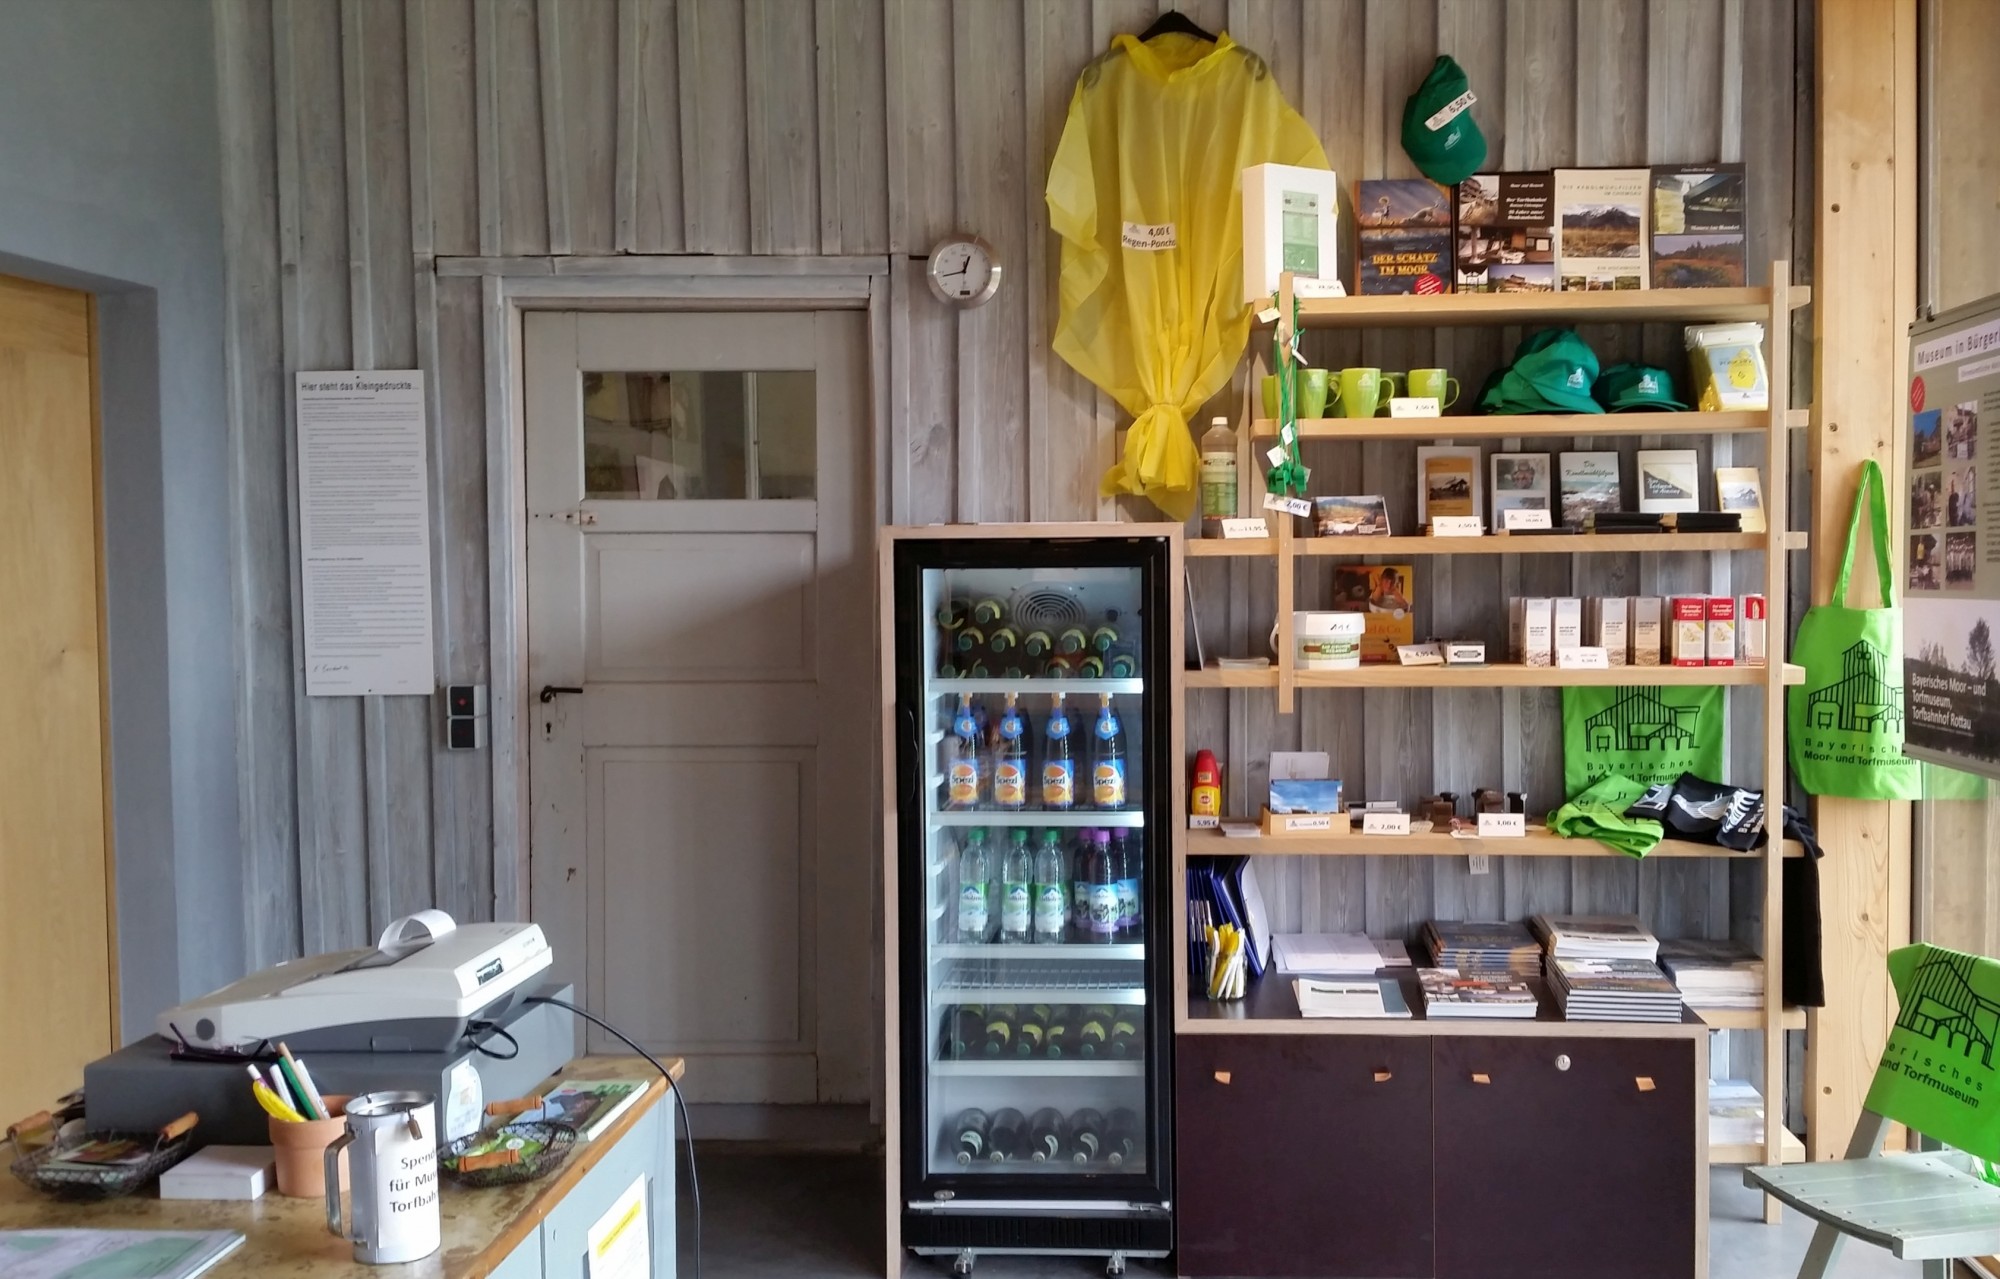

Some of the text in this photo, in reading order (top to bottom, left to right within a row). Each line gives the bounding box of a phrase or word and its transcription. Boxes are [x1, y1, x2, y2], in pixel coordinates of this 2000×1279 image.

[1372, 252, 1439, 265] DER SCHATZ
[1379, 264, 1430, 275] IM MOOR
[1917, 327, 2000, 365] Museum in Bürger
[300, 382, 318, 392] Hier
[319, 382, 338, 391] steht
[340, 382, 353, 391] das
[1912, 672, 1948, 690] Bayerisches
[1949, 677, 1967, 693] Moor
[1973, 681, 1987, 697] und
[1912, 689, 1952, 710] Torfmuseum,
[1912, 705, 1950, 726] Torfbahnhof
[1950, 712, 1972, 730] Rottau
[1804, 737, 1898, 753] Bayerisch
[1586, 760, 1693, 771] Bayerisches
[1804, 750, 1917, 766] Moor- und Torfmuseum
[1903, 1064, 1980, 1109] Torfmuseum
[389, 1178, 410, 1193] für
[389, 1190, 438, 1213] Torfbah
